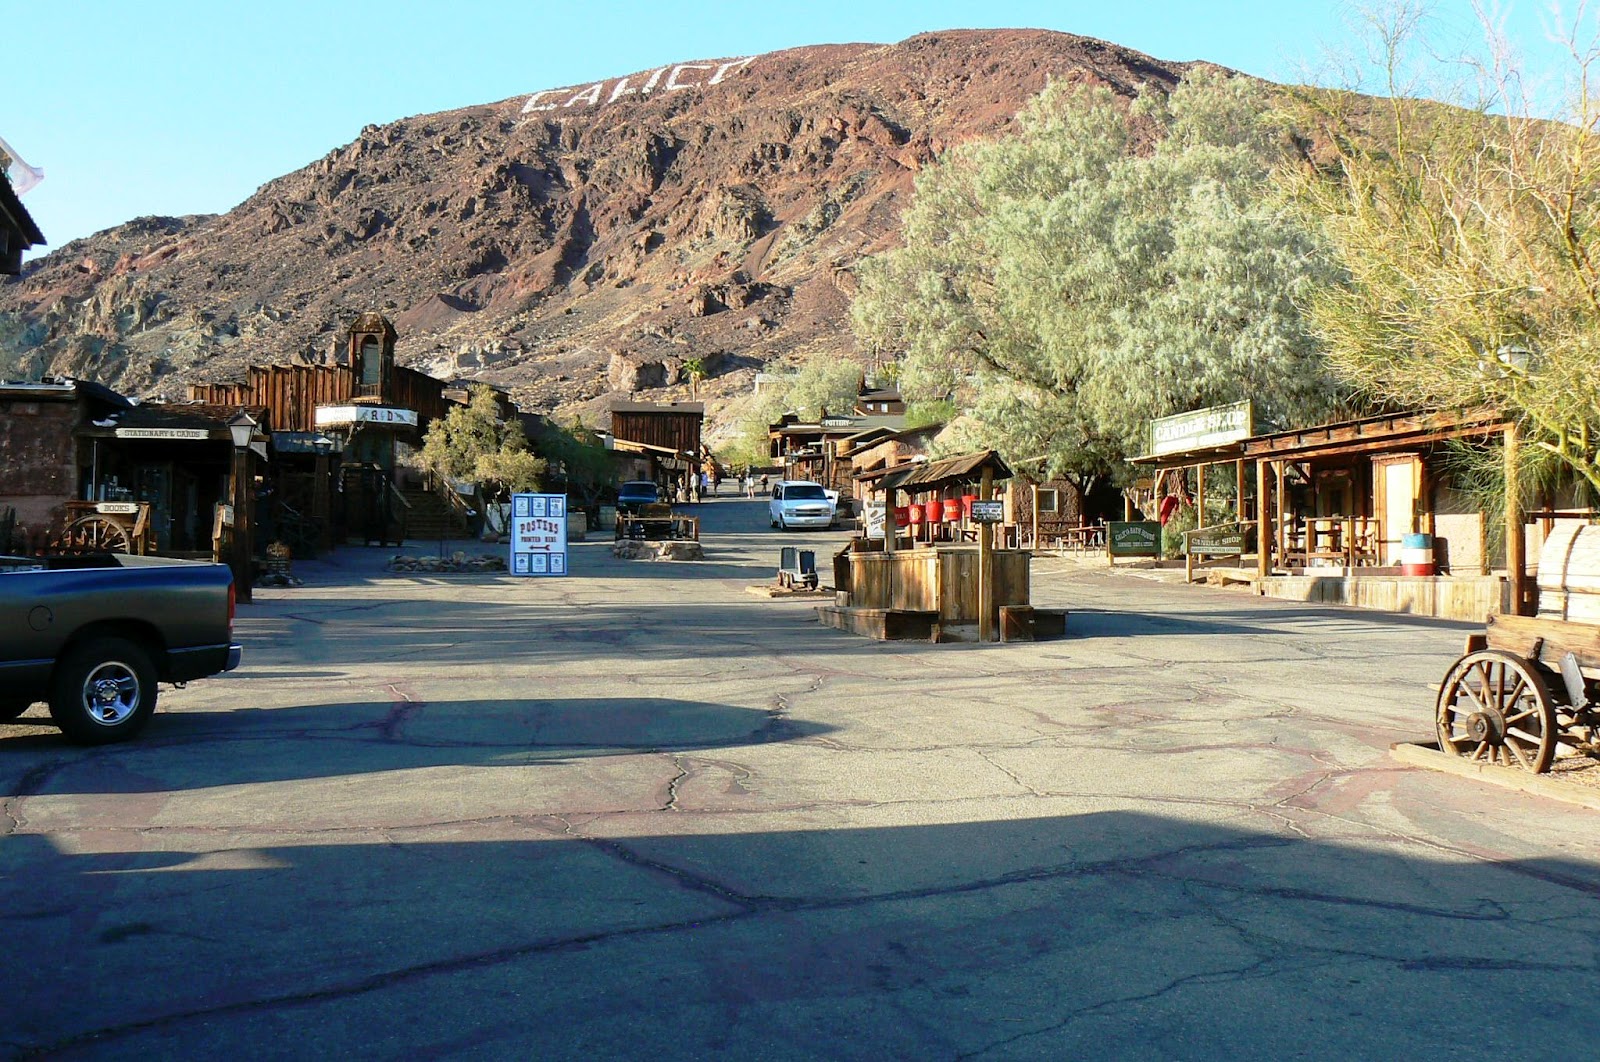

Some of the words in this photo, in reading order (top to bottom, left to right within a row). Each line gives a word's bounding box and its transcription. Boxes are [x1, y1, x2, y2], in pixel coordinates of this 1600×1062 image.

[1207, 410, 1247, 428] SHOP
[124, 429, 170, 438] STATIONARY
[170, 430, 175, 438] &
[176, 430, 200, 438] CARDS
[104, 504, 130, 512] BOOKS
[520, 518, 559, 534] POSTERS
[1191, 537, 1220, 546] CANDLE
[1222, 536, 1242, 545] SHOP
